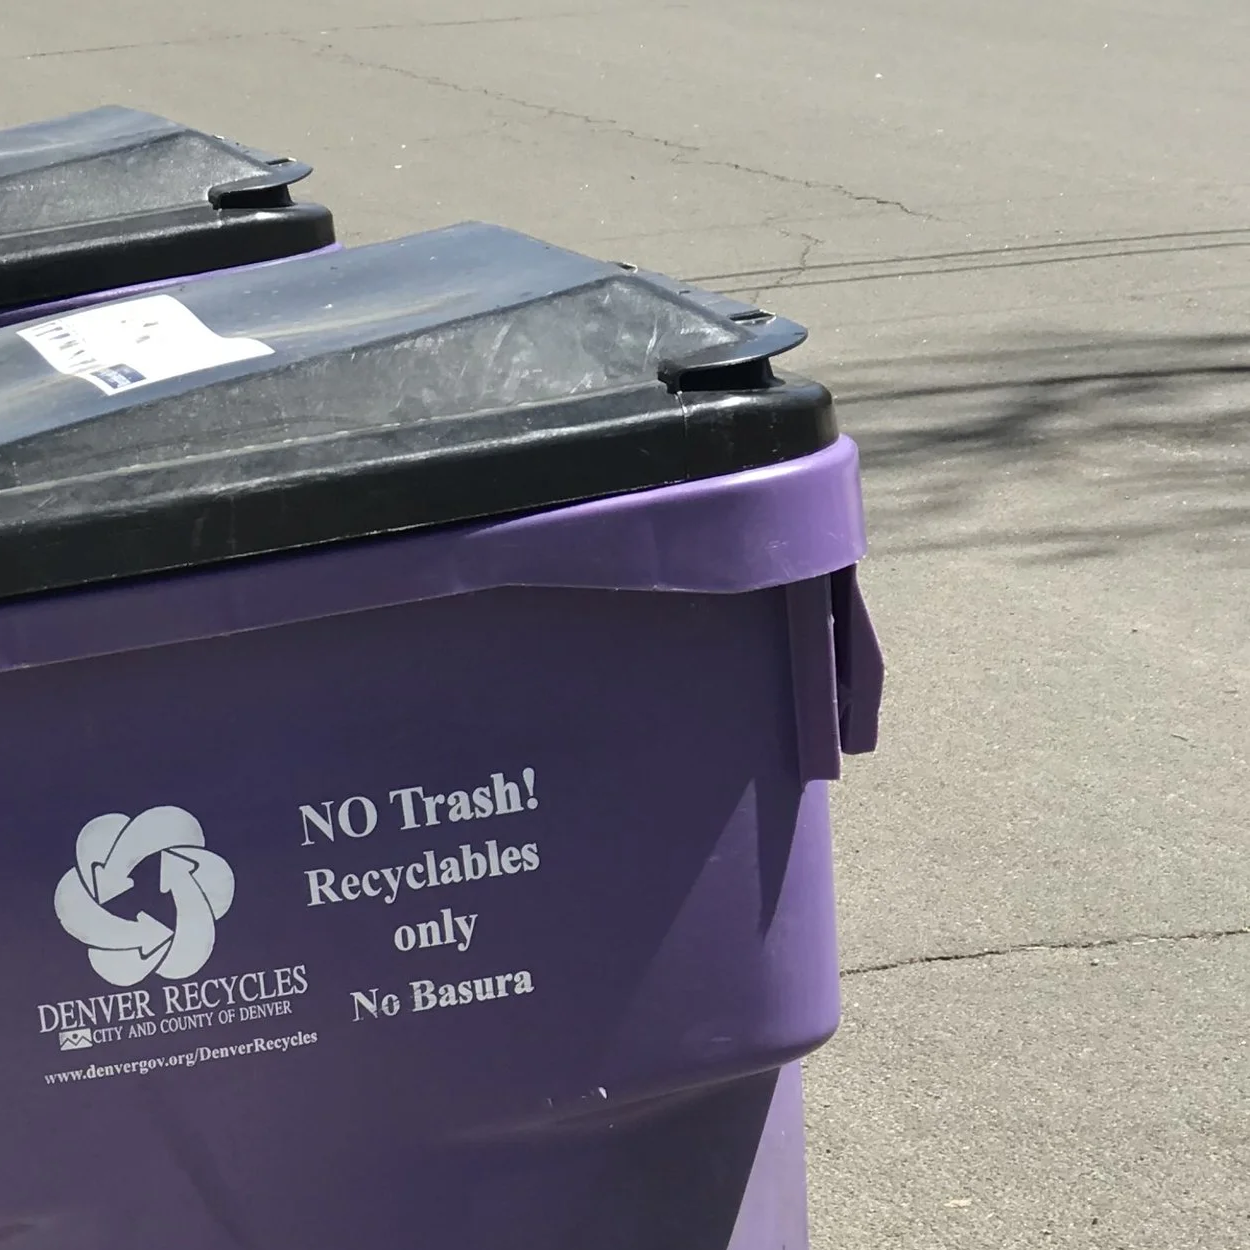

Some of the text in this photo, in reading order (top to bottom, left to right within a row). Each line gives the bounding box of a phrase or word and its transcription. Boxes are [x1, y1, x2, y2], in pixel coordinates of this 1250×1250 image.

[300, 768, 539, 845] NO Trash!
[306, 841, 540, 906] Recyclables
[394, 909, 478, 951] only
[38, 965, 309, 1033] DENVER RECYCLES
[93, 1001, 292, 1044] CITY AND COUNTY OF DENVER
[351, 970, 535, 1021] No Basura
[44, 1031, 318, 1085] www.denvergov.org/DenverRecycles
